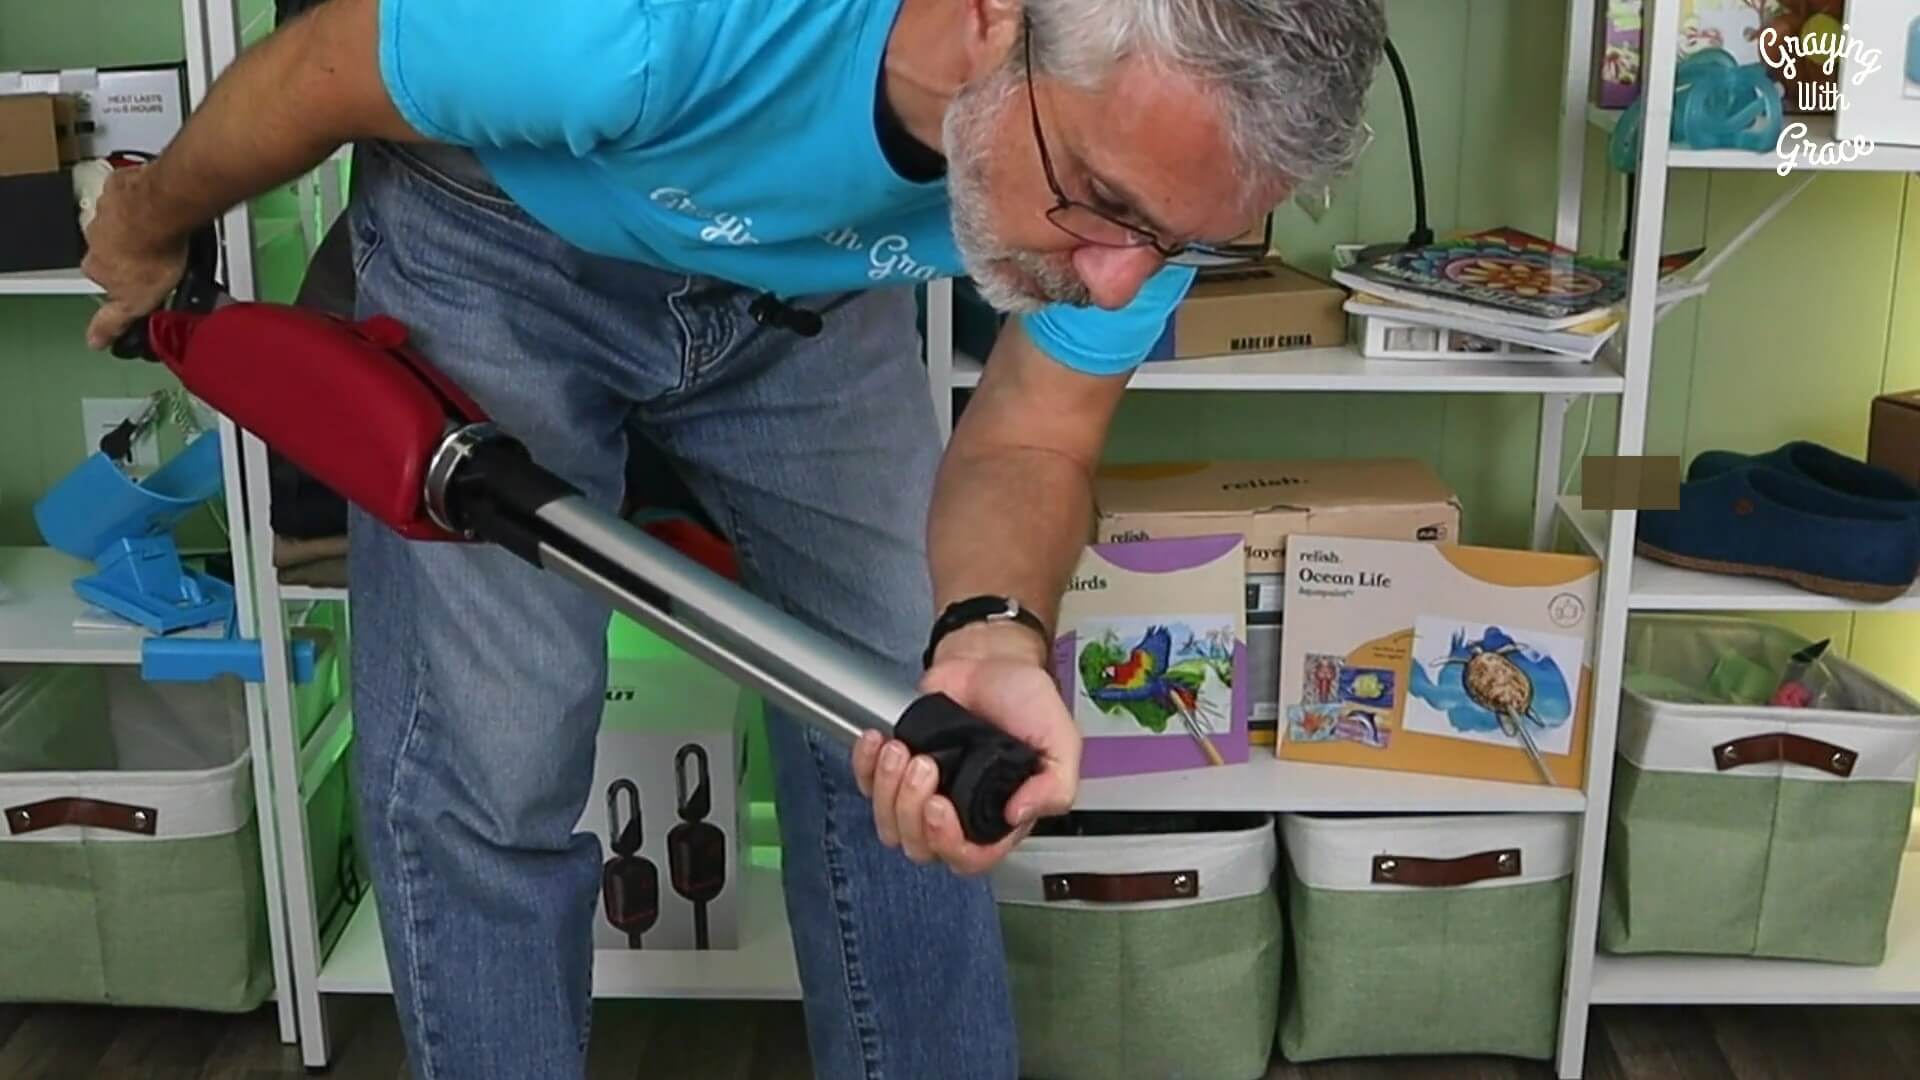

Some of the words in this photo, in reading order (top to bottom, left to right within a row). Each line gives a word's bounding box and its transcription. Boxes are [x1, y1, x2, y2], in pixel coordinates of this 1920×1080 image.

[867, 234, 938, 279] Gra
[1230, 337, 1261, 351] MADE
[1263, 336, 1276, 349] IN
[1278, 333, 1312, 348] CHINA
[1298, 566, 1355, 586] Ocean
[1358, 571, 1391, 589] Life
